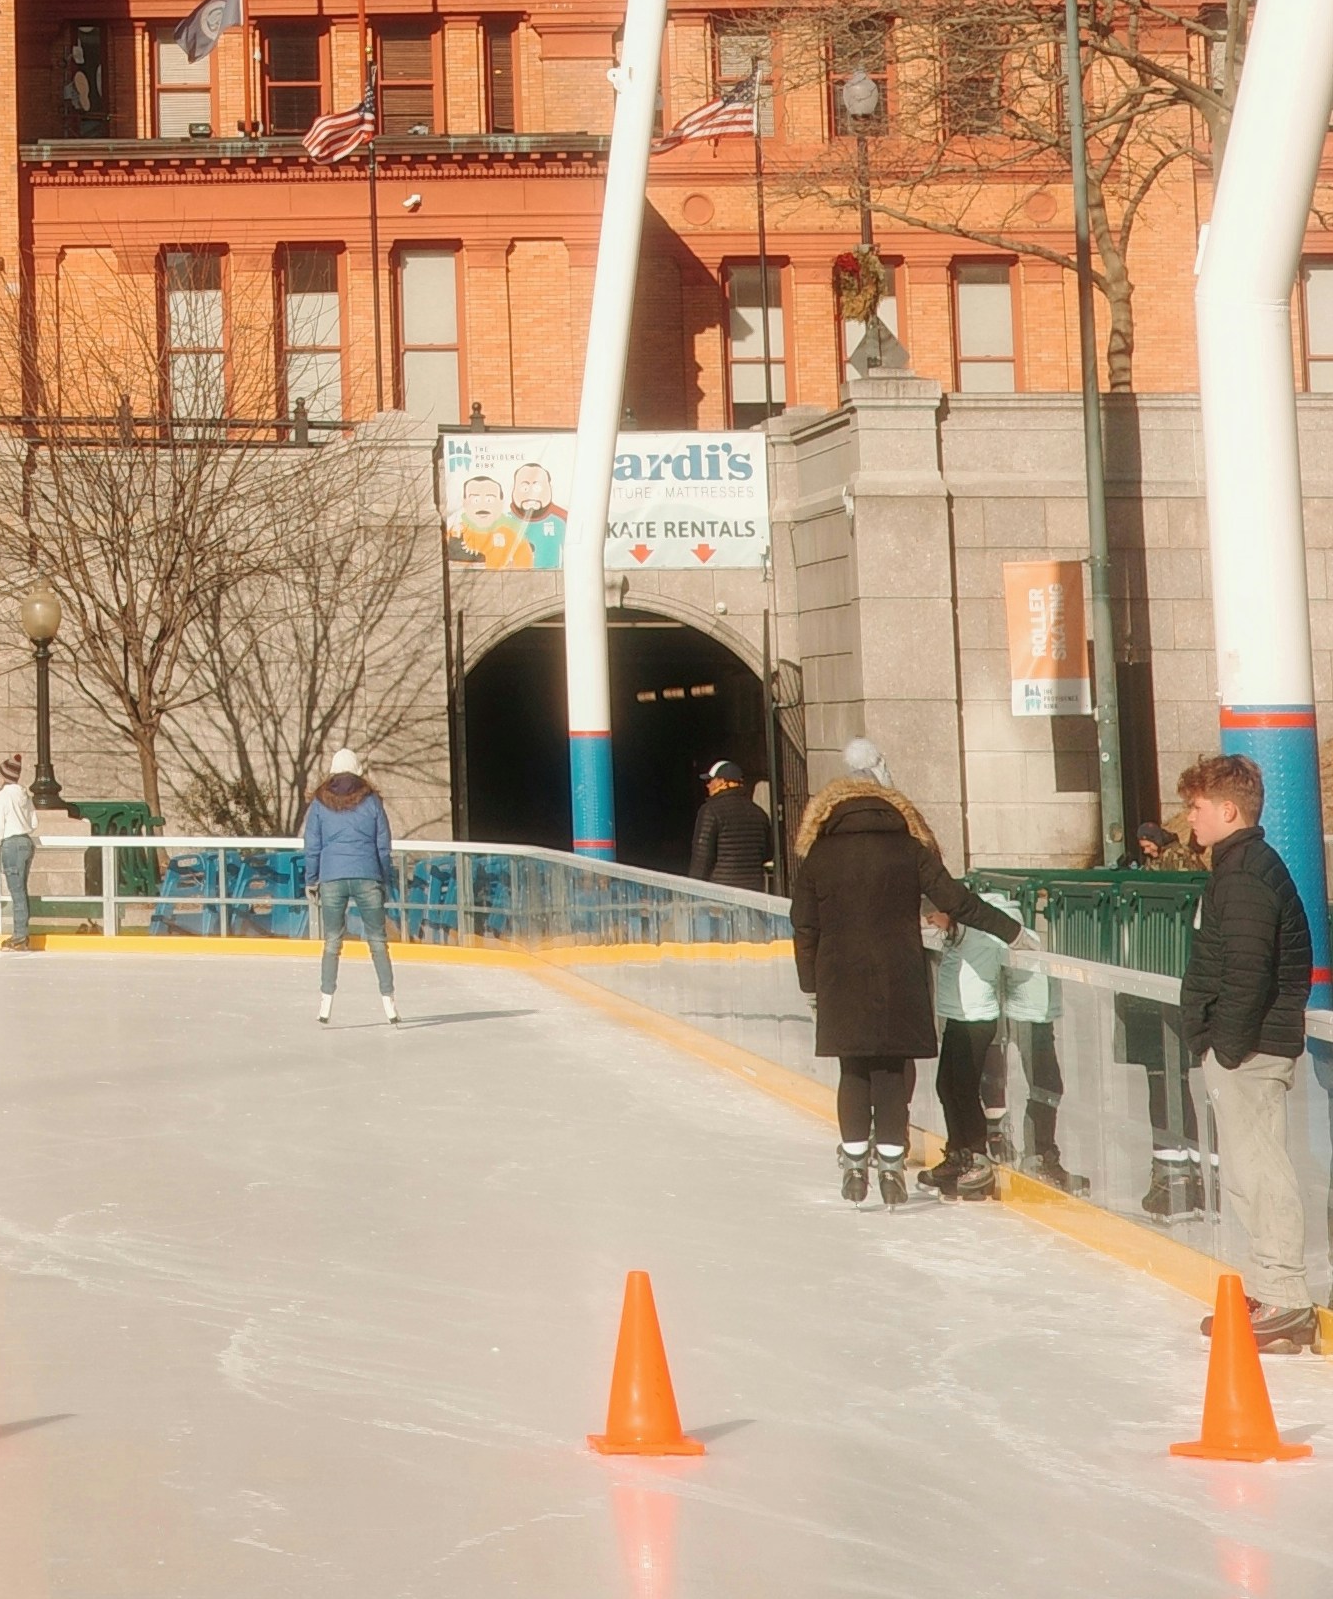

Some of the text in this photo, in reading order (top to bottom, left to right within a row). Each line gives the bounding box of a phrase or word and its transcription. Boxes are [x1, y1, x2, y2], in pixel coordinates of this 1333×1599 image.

[613, 442, 754, 481] ardi's
[665, 486, 754, 499] MATTRESSES
[606, 520, 756, 539] KATE RENTALS
[1028, 588, 1047, 657] ROLLER
[1048, 582, 1067, 660] SKATING
